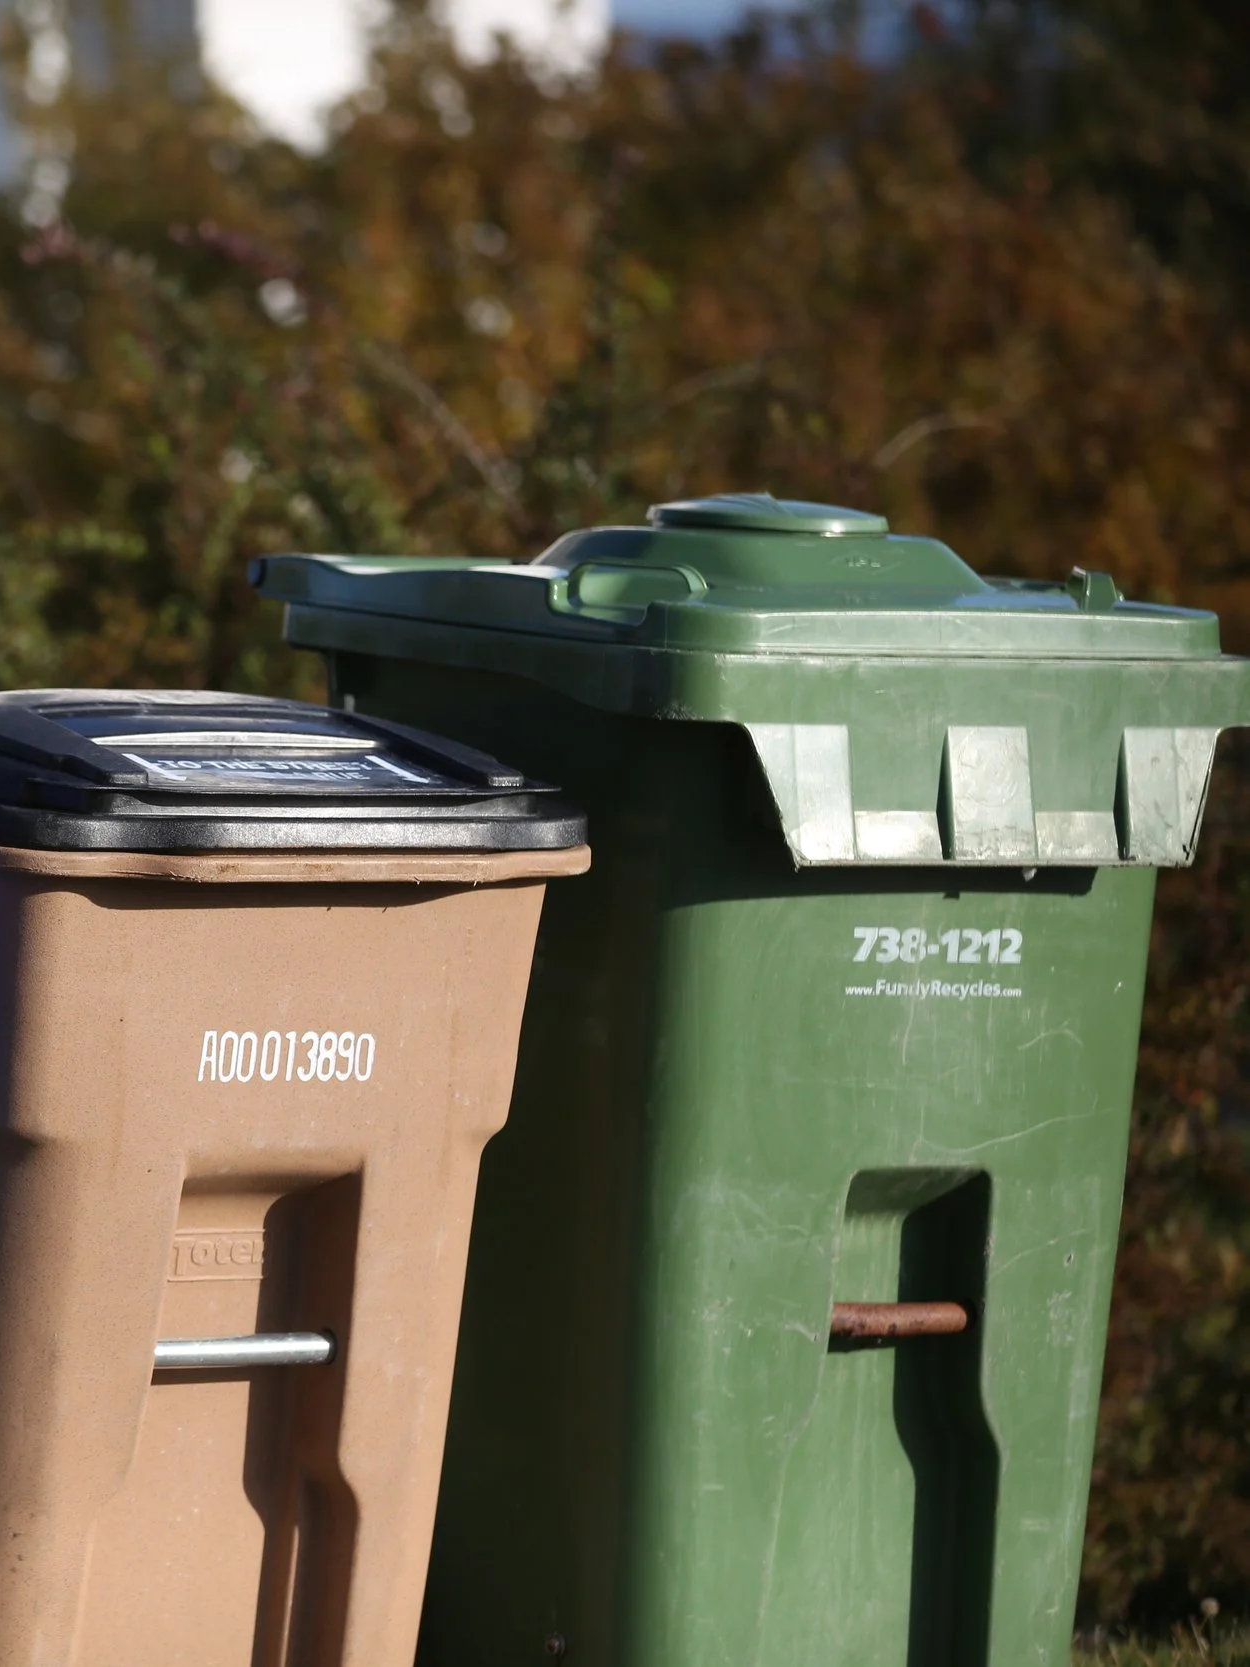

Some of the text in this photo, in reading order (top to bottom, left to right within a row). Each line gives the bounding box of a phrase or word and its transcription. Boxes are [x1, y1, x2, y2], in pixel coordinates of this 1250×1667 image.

[853, 926, 1023, 964] 738-1212
[845, 978, 1022, 1000] www.FundyRecycles.com
[197, 1030, 376, 1083] A00013890
